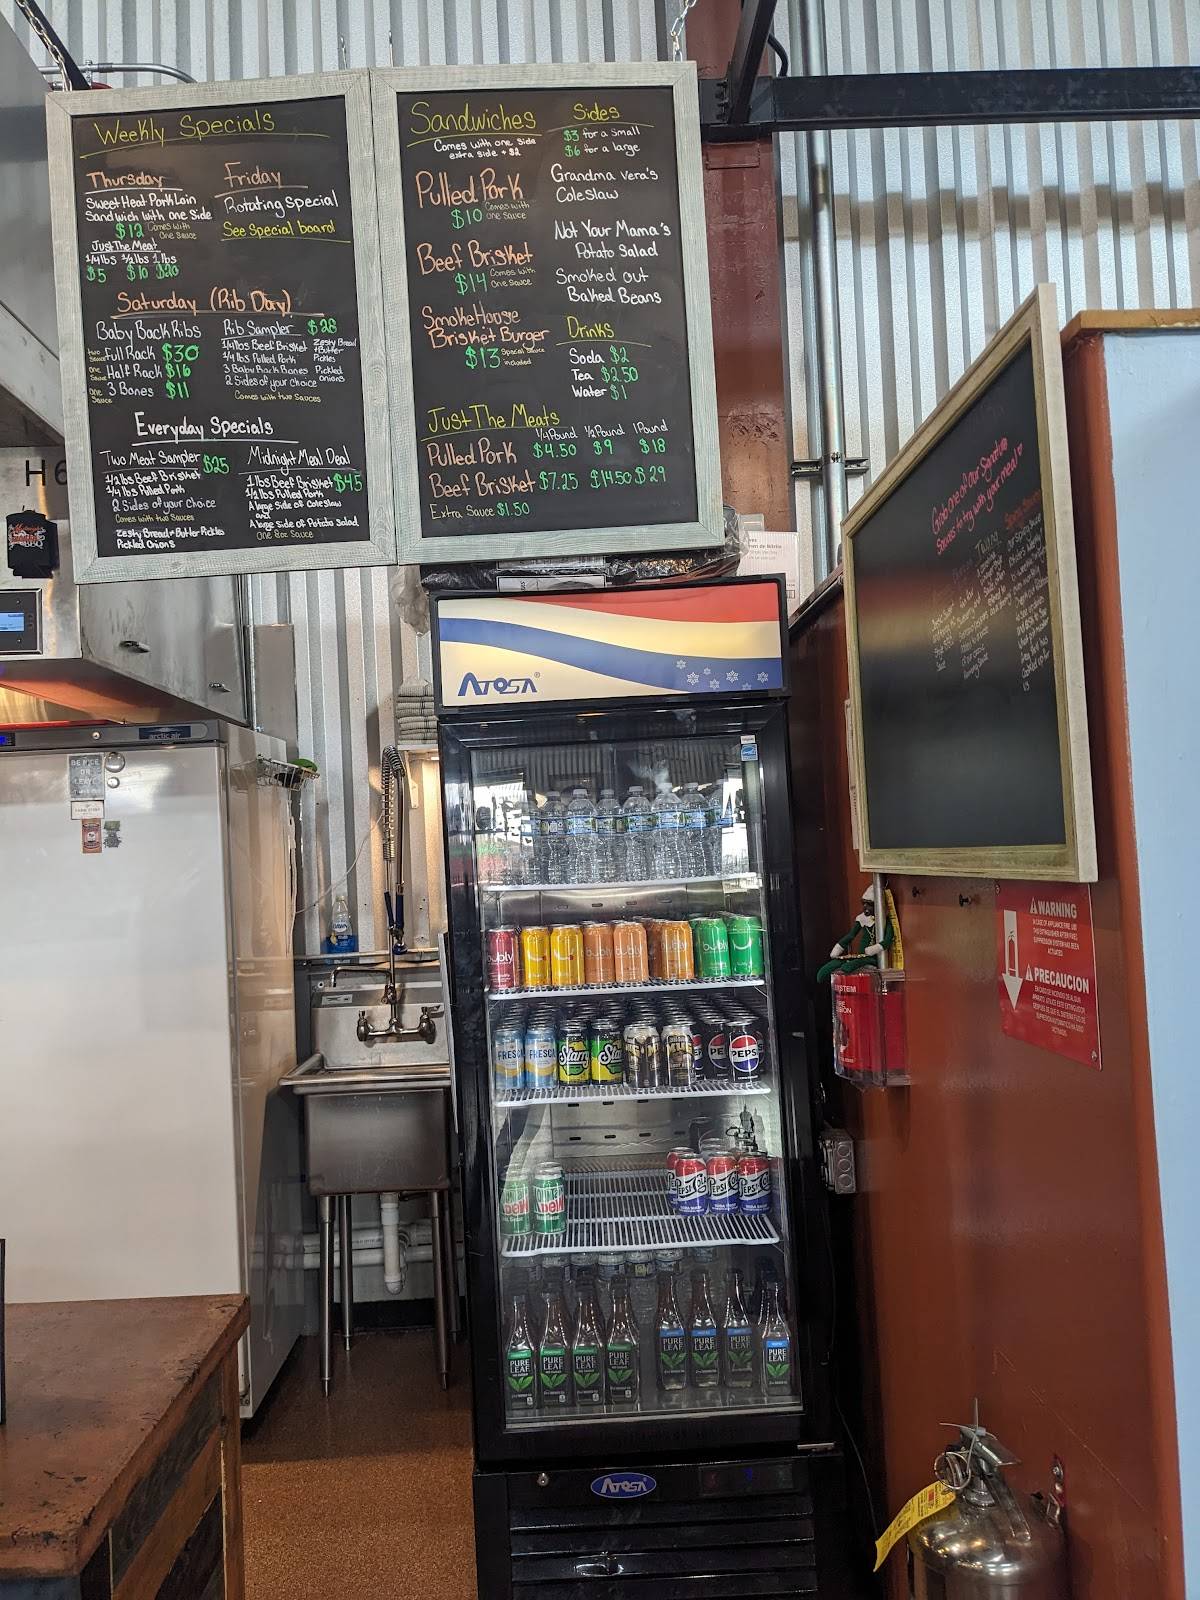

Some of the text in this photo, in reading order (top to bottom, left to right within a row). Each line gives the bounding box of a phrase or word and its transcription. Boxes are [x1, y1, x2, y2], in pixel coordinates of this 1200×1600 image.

[410, 101, 537, 134] Sandwiches
[573, 102, 620, 121] Sides
[94, 110, 275, 147] Weekly Specials
[563, 129, 579, 142] $3
[582, 128, 598, 139] for
[434, 139, 468, 152] Comes
[564, 145, 580, 157] $6
[584, 143, 598, 154] for
[612, 141, 640, 157] large
[86, 171, 165, 192] Thursday
[224, 162, 281, 189] Friday
[550, 163, 616, 183] Grandma
[416, 168, 523, 208] Pulled Pork
[556, 186, 619, 203] Coleslaw
[86, 193, 197, 209] Sweet Heat Pork Loin
[224, 195, 285, 218] Rotating
[85, 210, 139, 222] Sandwich
[169, 211, 188, 221] one
[451, 208, 482, 229] $10
[115, 220, 144, 240] $12
[223, 221, 246, 237] See
[297, 219, 335, 234] board
[554, 219, 671, 240] Not Your Mama's
[91, 238, 158, 252] Just The Meat
[575, 241, 659, 259] Potato Salad
[416, 239, 534, 275] Beef Brisket
[86, 265, 107, 283] $5
[126, 263, 149, 281] $10
[555, 267, 617, 284] Smoked
[455, 272, 488, 296] $14
[117, 287, 291, 317] Saturday (Rib Day)
[567, 286, 662, 305] Baked Beans
[96, 319, 201, 346] Baby Back Ribs
[223, 318, 338, 339] Rib Sampler $28
[567, 315, 615, 339] Drinks
[252, 339, 275, 351] Beef
[428, 325, 551, 350] Brisket Burger
[126, 345, 155, 360] Rack
[162, 342, 200, 362] $30
[465, 345, 501, 370] $13
[569, 345, 630, 364] Soda $2
[106, 363, 130, 379] Half
[133, 363, 162, 379] Rack
[571, 368, 594, 381] Tea
[107, 380, 190, 400] 3 Bones $11
[269, 377, 287, 392] your
[571, 383, 628, 401] Water $1
[135, 411, 274, 444] Everyday Specials
[427, 403, 560, 433] Just The Meats
[100, 449, 230, 475] Two Meat Sampler $25
[247, 445, 351, 476] Midnight Meal Deal
[427, 437, 666, 467] Pulled Pork $4.50 $9 $18
[25, 459, 46, 487] H
[135, 470, 202, 484] Beef Brisket
[270, 472, 363, 493] Beef Brisket $45
[429, 472, 470, 498] Beef
[475, 469, 536, 496] Brisket
[539, 471, 579, 490] $7.25
[635, 465, 667, 485] $29
[275, 488, 302, 499] Pulled
[430, 502, 530, 520] Extra Sauce $1.50
[458, 672, 537, 697] ATOSA
[1037, 899, 1077, 919] WARNING
[1034, 966, 1090, 994] PRECAUCION
[731, 1048, 758, 1058] PEPS
